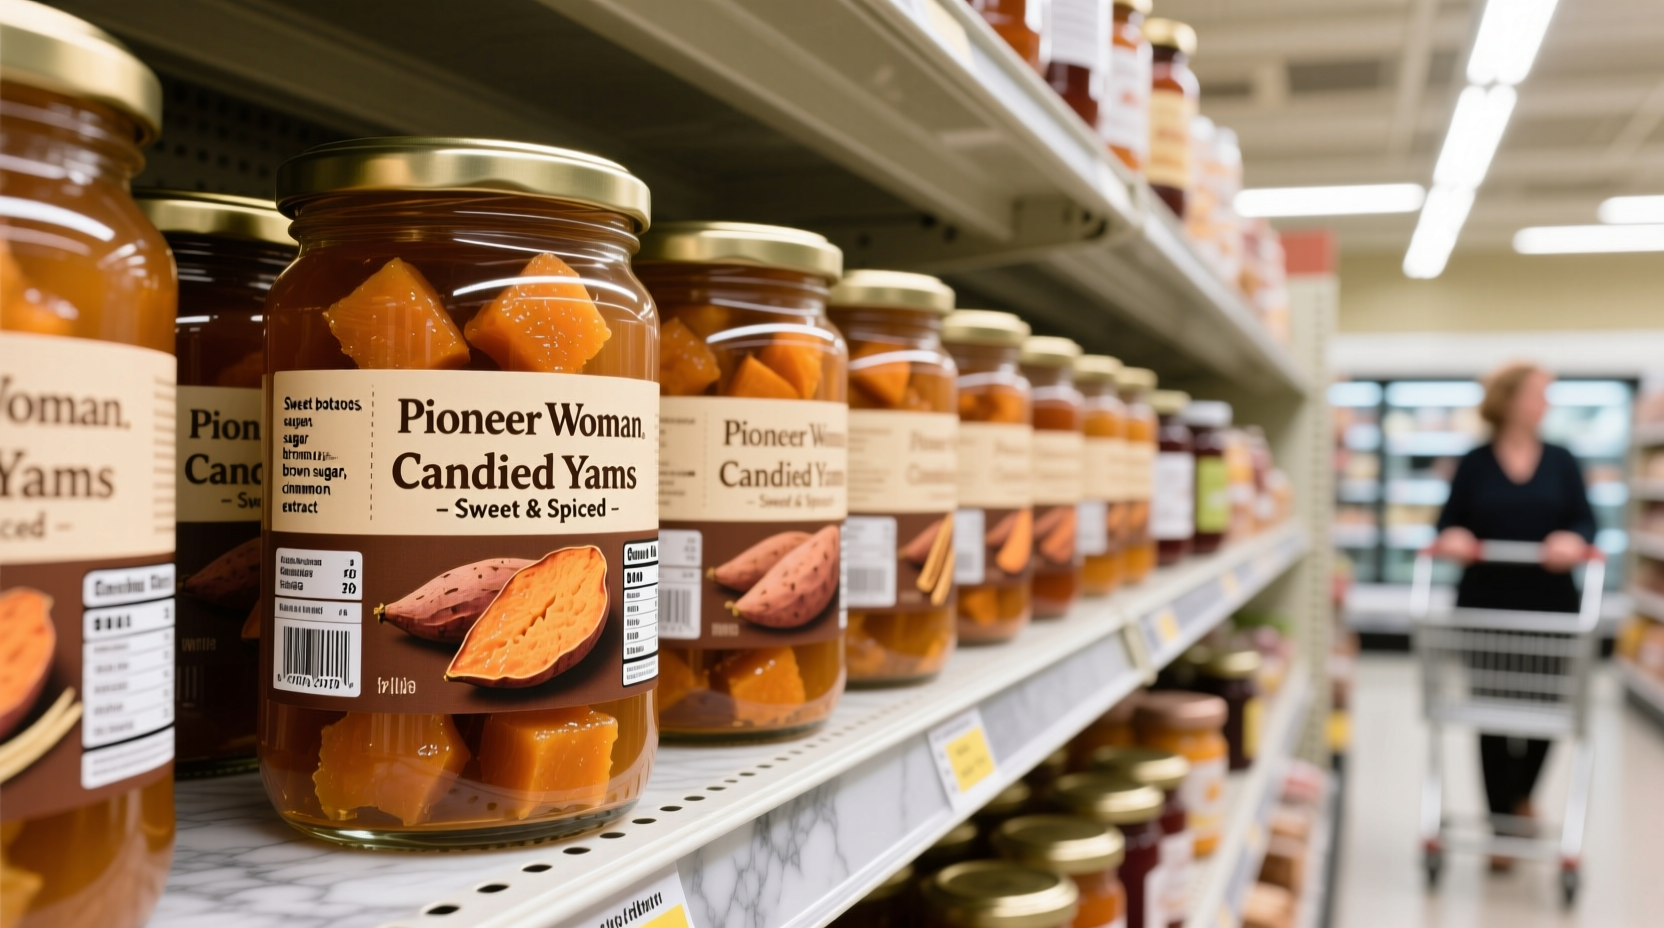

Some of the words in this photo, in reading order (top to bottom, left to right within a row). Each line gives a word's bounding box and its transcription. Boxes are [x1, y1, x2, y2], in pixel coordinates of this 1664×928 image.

[397, 398, 543, 435] Pioneer
[722, 419, 807, 447] Pioneer
[392, 451, 555, 490] Candied
[561, 455, 637, 490] Yams
[719, 460, 812, 488] Candied
[454, 498, 520, 519] Sweet
[525, 498, 542, 519] &
[547, 498, 606, 524] Spiced
